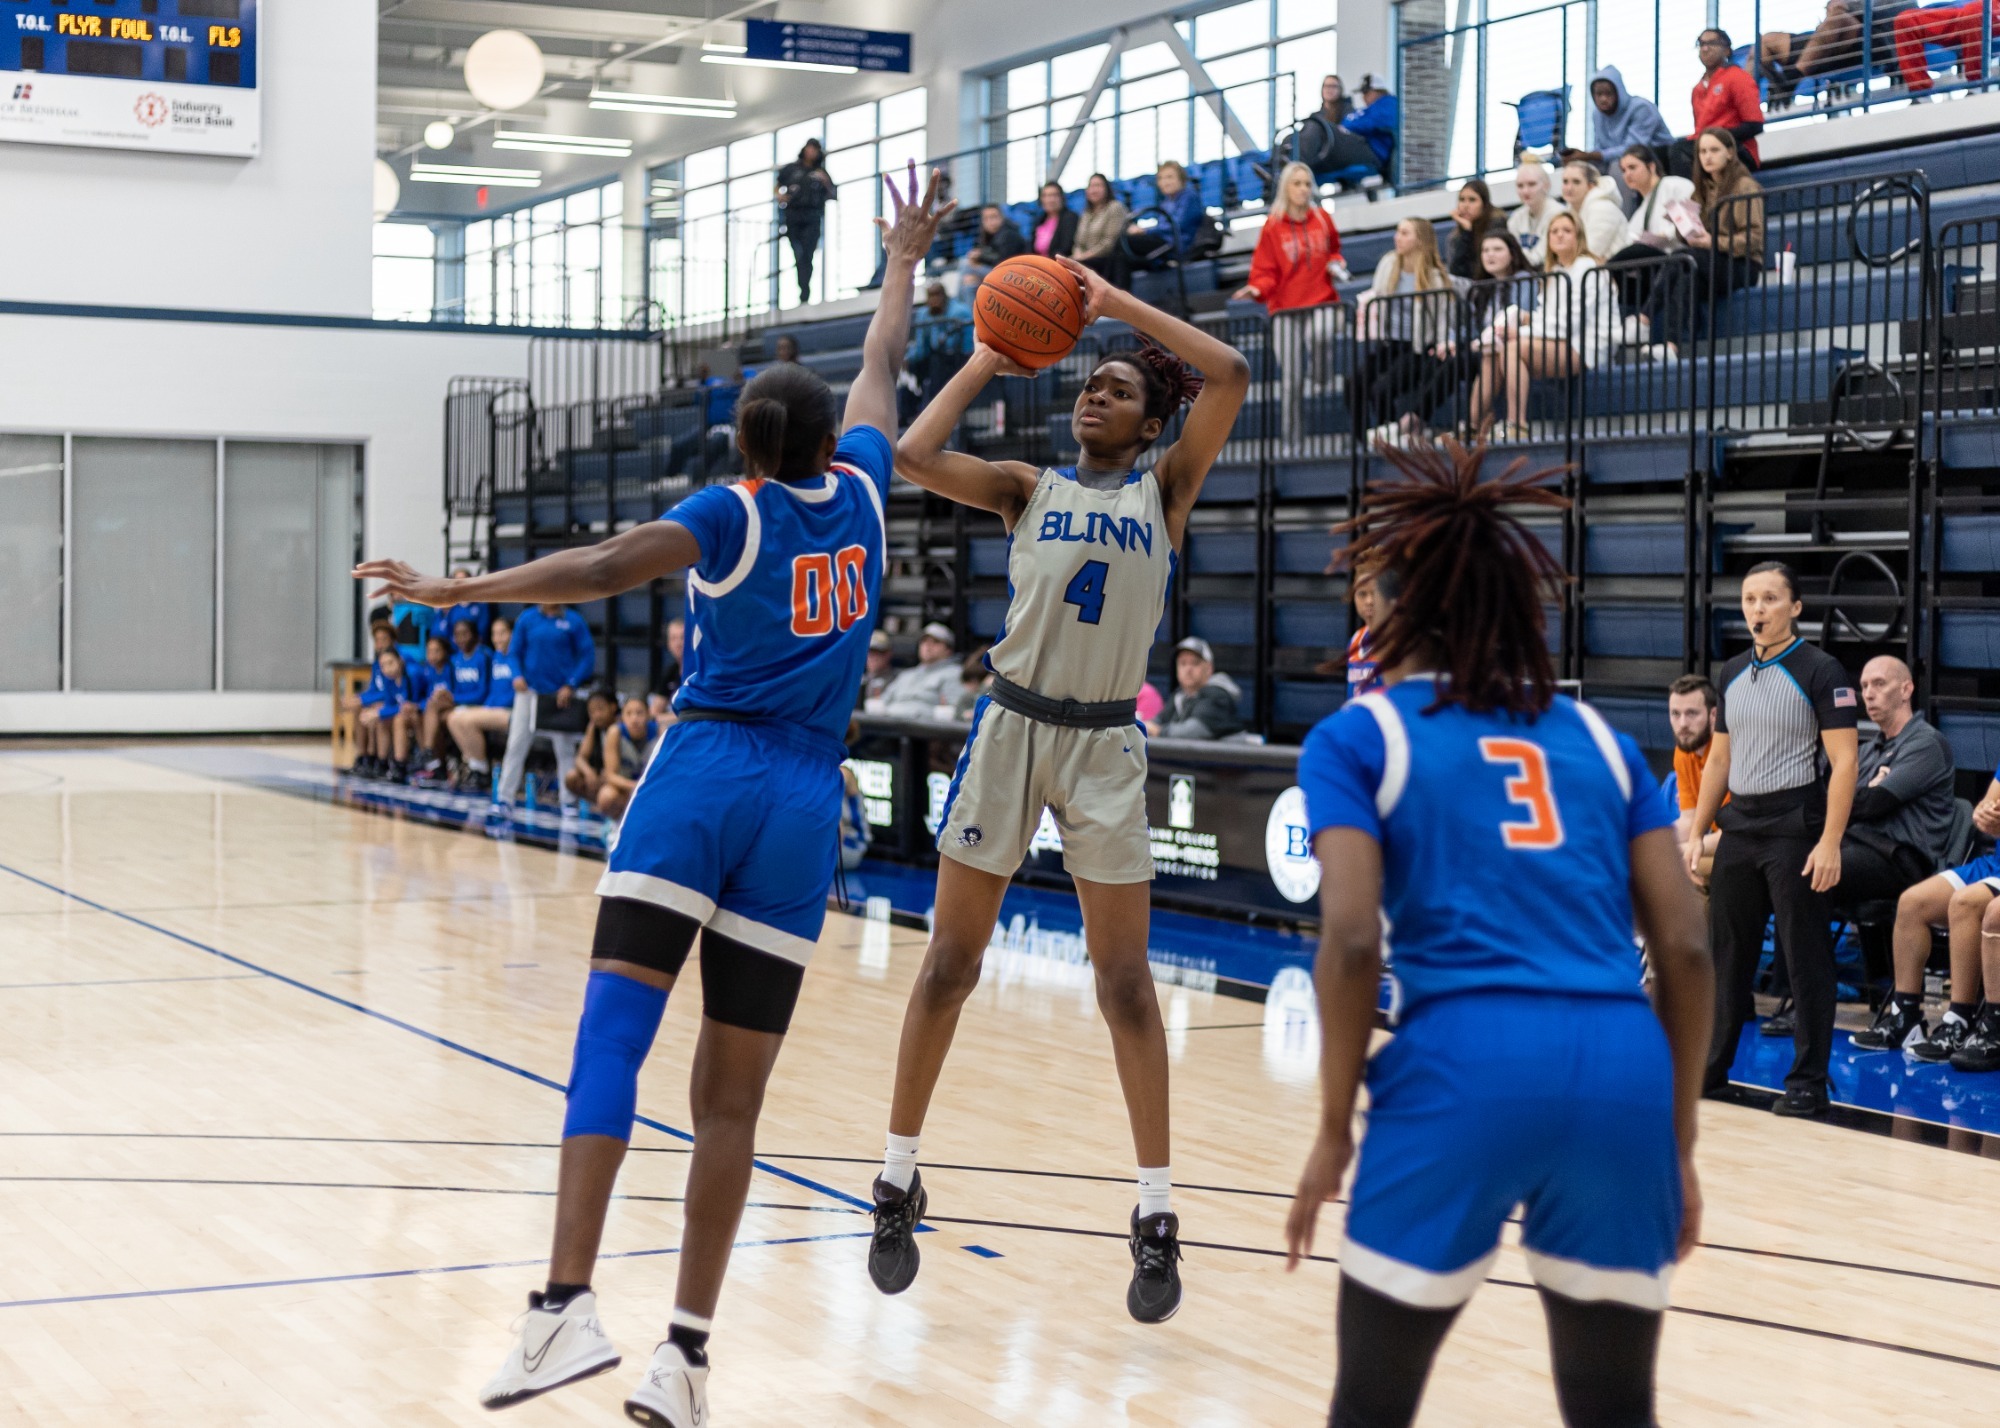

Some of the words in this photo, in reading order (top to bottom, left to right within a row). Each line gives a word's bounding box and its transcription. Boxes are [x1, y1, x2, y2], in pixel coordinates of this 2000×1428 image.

[59, 13, 101, 37] PLYR
[110, 18, 153, 41] FOUL
[209, 26, 241, 48] FLS
[985, 294, 1056, 345] SPALDING
[1037, 511, 1152, 558] BLINN
[791, 543, 868, 637] 00
[1063, 559, 1110, 626] 4
[1478, 737, 1565, 850] 3
[1285, 824, 1308, 860] B
